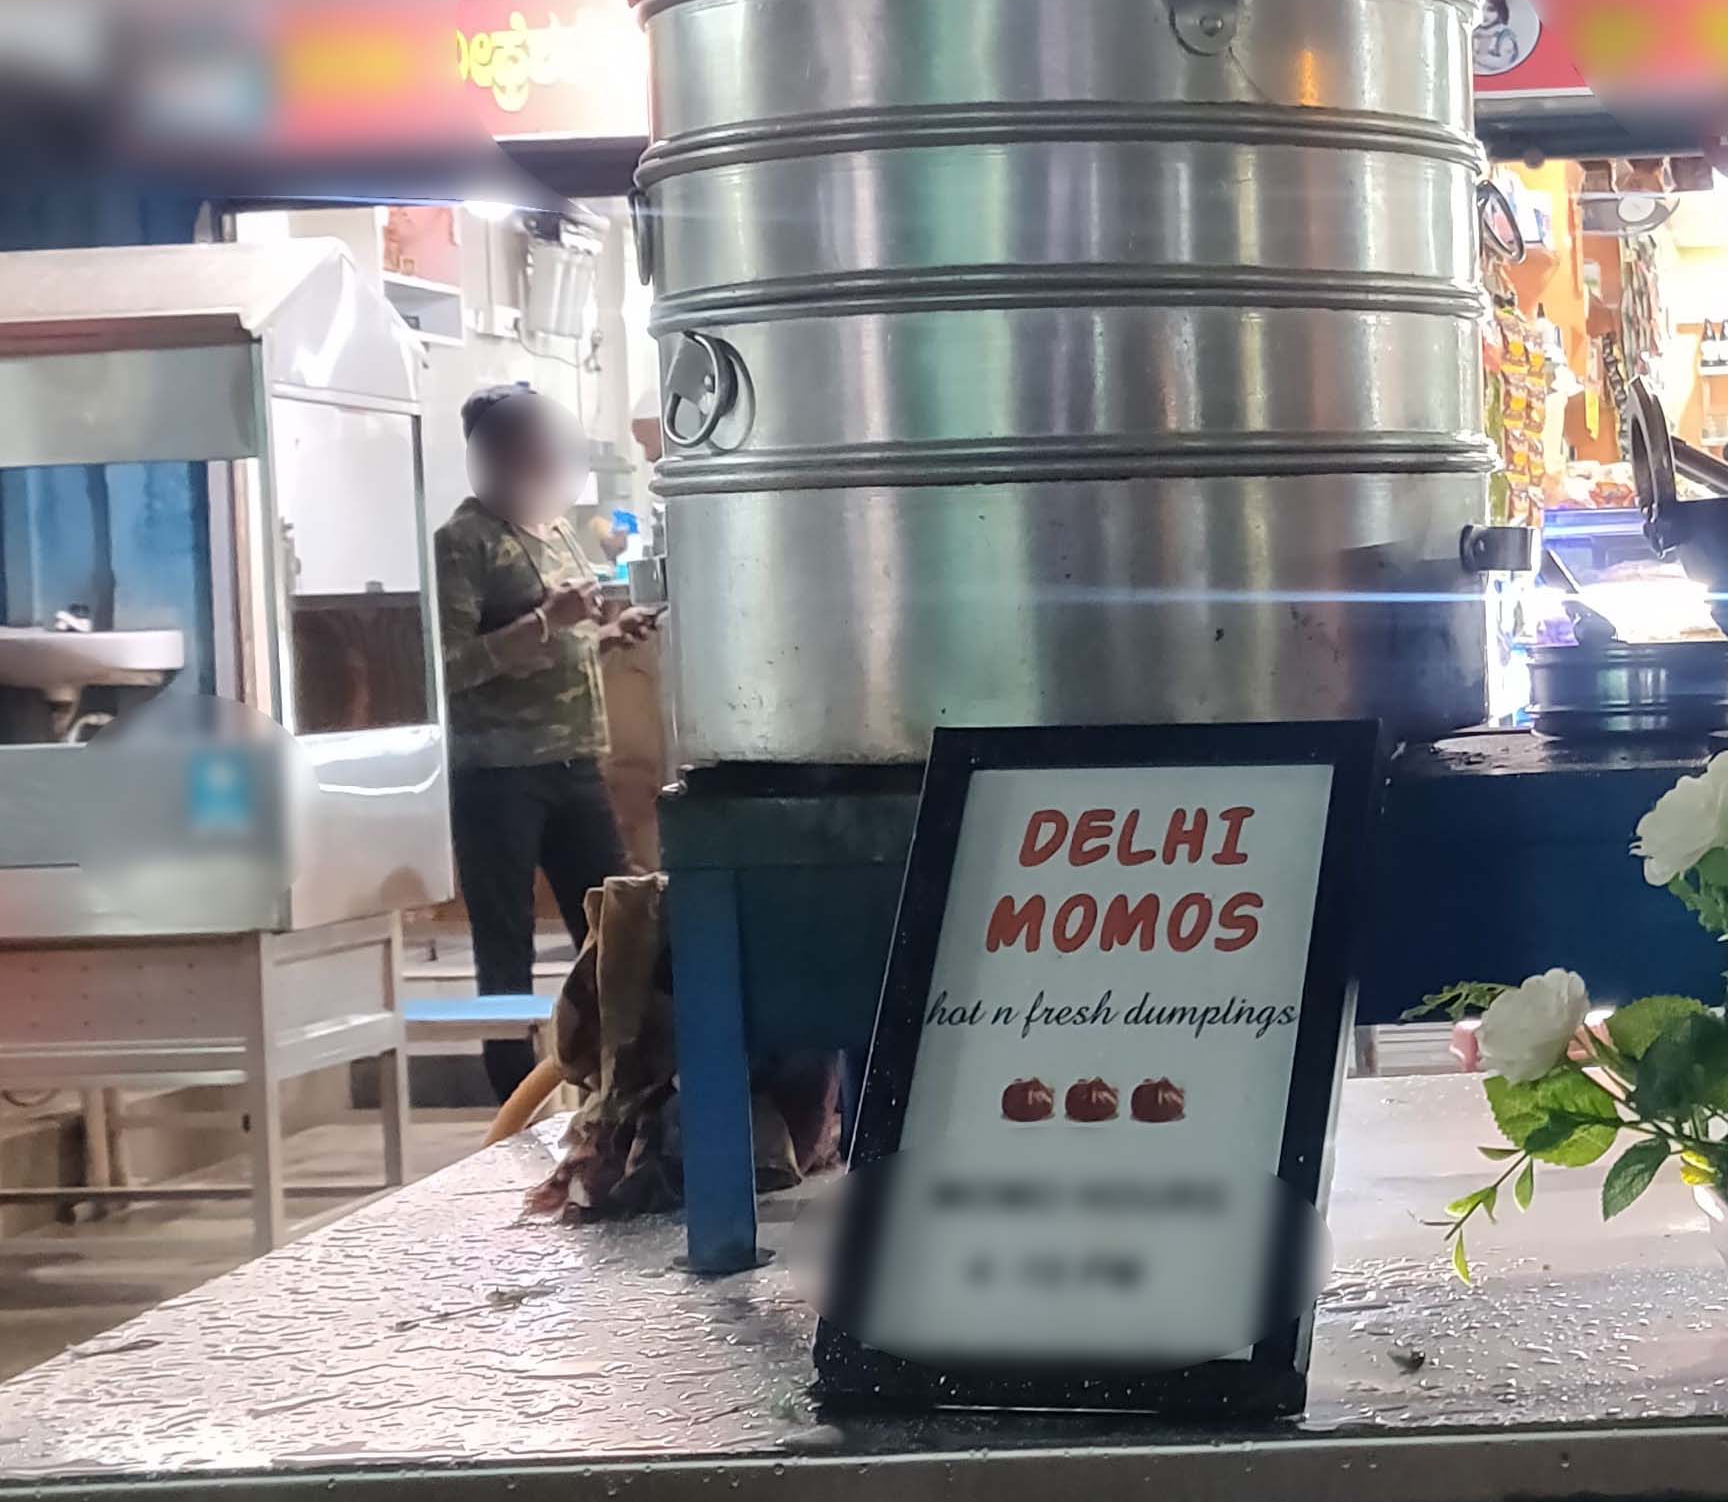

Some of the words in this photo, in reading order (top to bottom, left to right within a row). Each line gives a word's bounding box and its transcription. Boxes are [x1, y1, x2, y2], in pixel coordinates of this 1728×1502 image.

[1018, 806, 1255, 867] DELHI
[985, 892, 1264, 953] MOMOS
[926, 990, 987, 1026] hot
[991, 1006, 1019, 1026] n
[1021, 989, 1119, 1038] fresh
